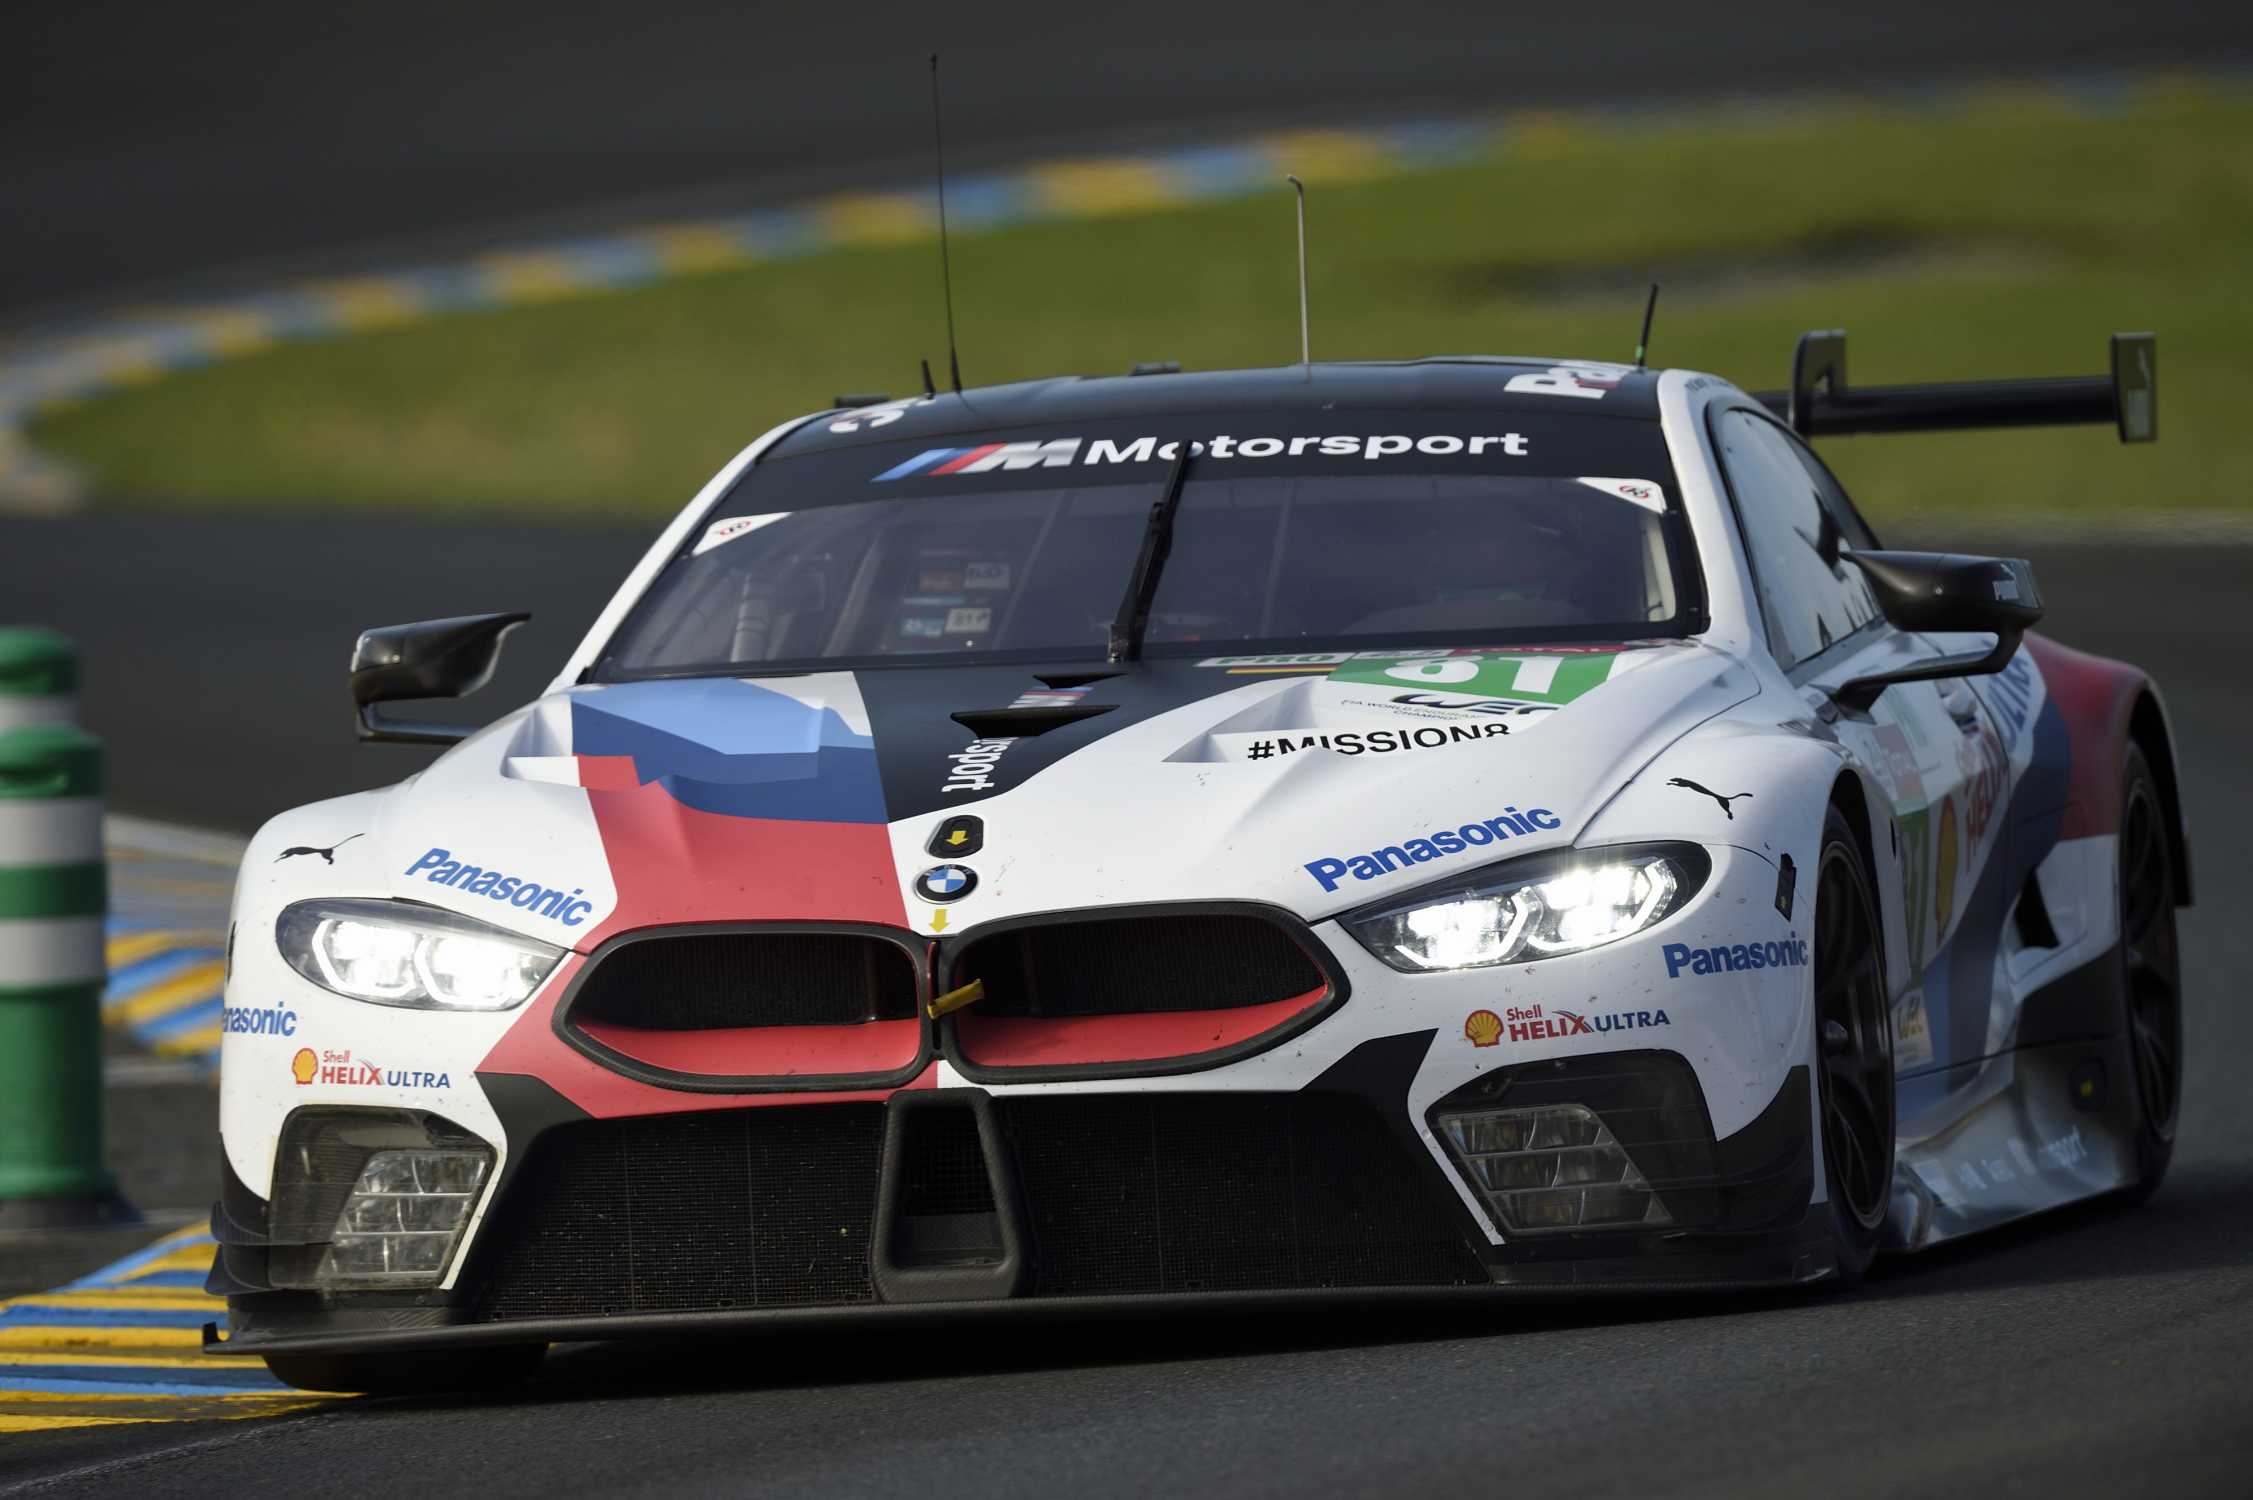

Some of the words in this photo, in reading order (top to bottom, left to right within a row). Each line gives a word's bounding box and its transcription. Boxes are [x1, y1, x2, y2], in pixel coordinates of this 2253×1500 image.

[1084, 432, 1529, 466] Motorsport
[1305, 807, 1561, 893] Panasonic
[405, 848, 592, 926] Panasonic
[1662, 932, 1809, 978] Panasonic
[1506, 1005, 1543, 1021] Shell
[1508, 1014, 1594, 1041] HELIX
[1594, 1009, 1671, 1031] ULTRA
[322, 1050, 351, 1063] Shell
[321, 1064, 385, 1086] HELIX
[387, 1071, 451, 1088] ULTRA
